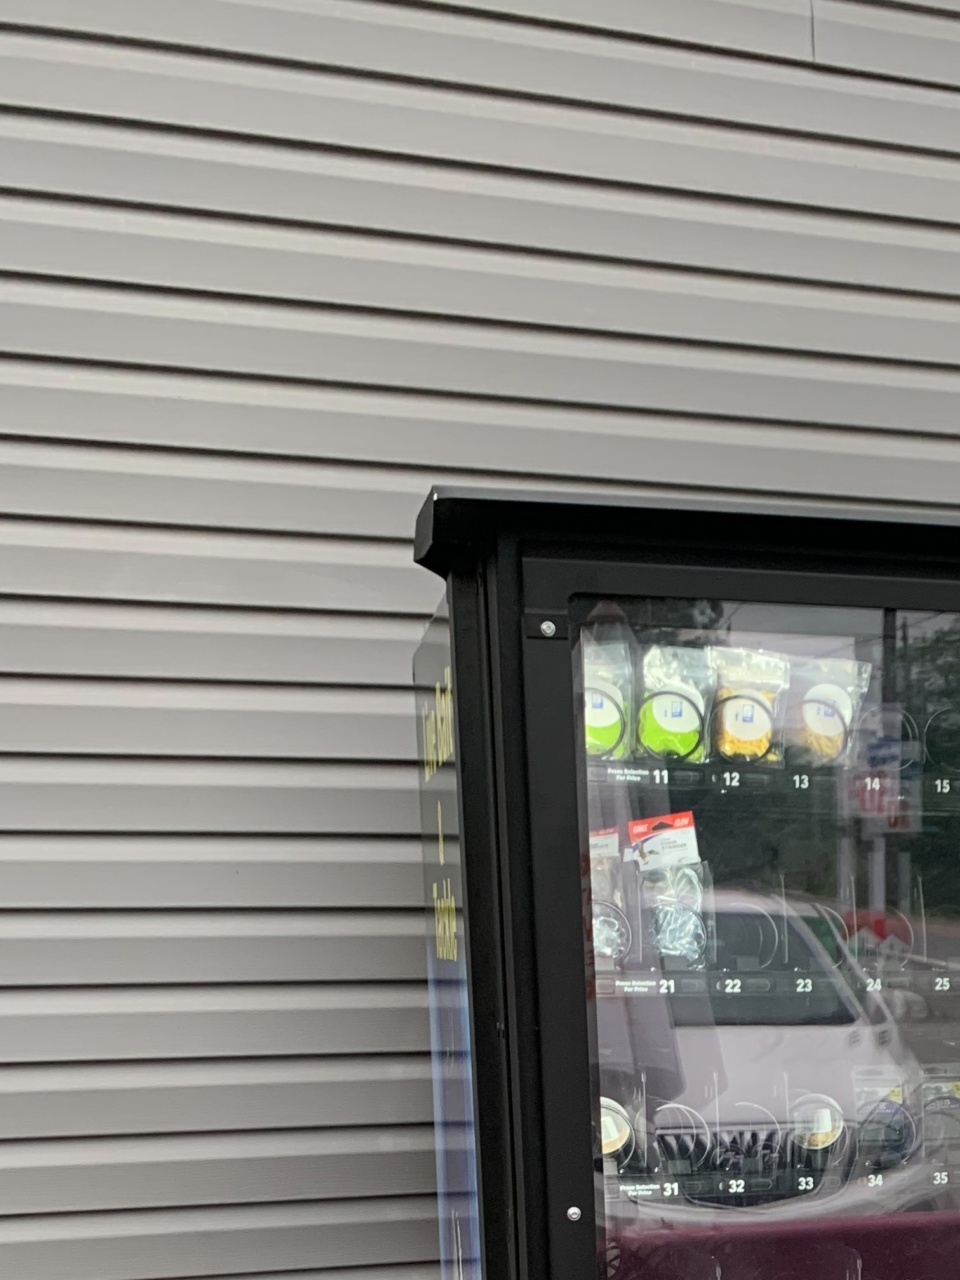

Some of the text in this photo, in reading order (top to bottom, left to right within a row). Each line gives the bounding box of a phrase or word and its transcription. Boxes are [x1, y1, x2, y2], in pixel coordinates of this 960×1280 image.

[653, 769, 669, 784] 11
[723, 772, 740, 787] 12
[793, 775, 809, 788] 13
[865, 776, 880, 790] 14
[935, 779, 950, 793] 15
[659, 978, 675, 994] 21
[725, 979, 742, 994] 22
[796, 979, 812, 992] 23
[866, 978, 882, 992] 24
[935, 978, 950, 991] 25
[798, 1177, 814, 1190] 33
[868, 1174, 883, 1188] 34
[933, 1172, 948, 1185] 35
[663, 1182, 678, 1196] 31
[729, 1180, 745, 1194] 32
